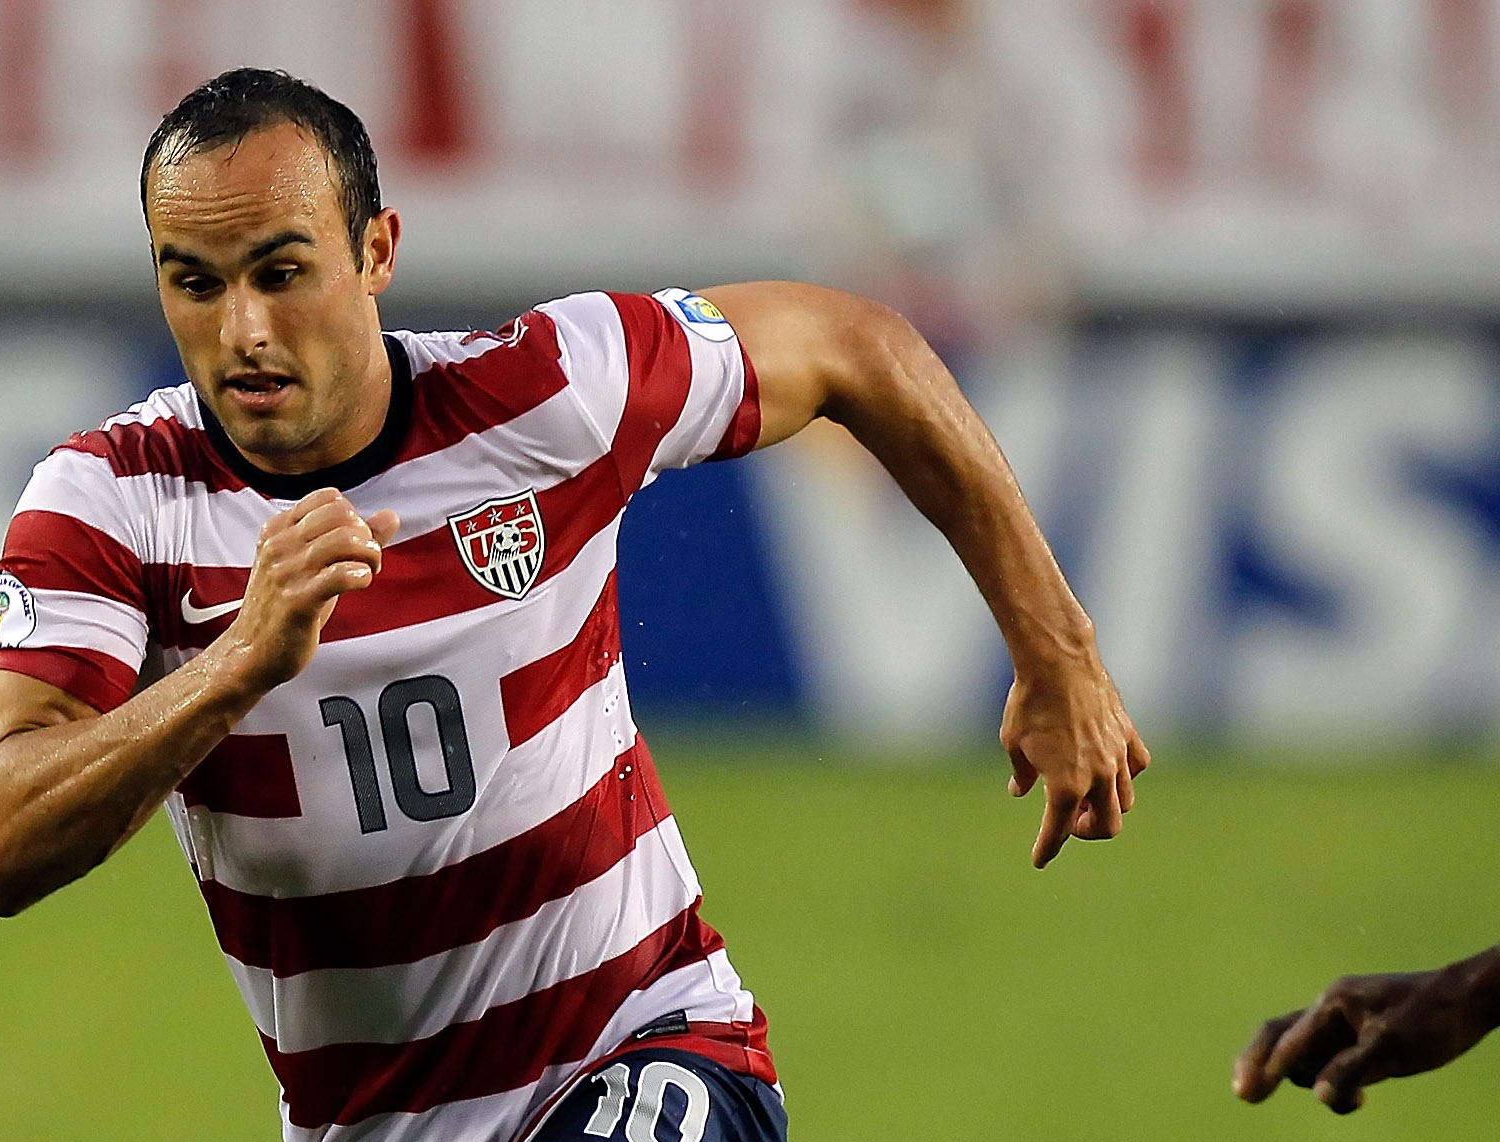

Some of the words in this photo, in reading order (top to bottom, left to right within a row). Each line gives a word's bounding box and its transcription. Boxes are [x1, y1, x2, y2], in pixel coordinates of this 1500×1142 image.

[468, 519, 539, 569] US
[735, 325, 1500, 752] VIS
[318, 674, 477, 835] 10
